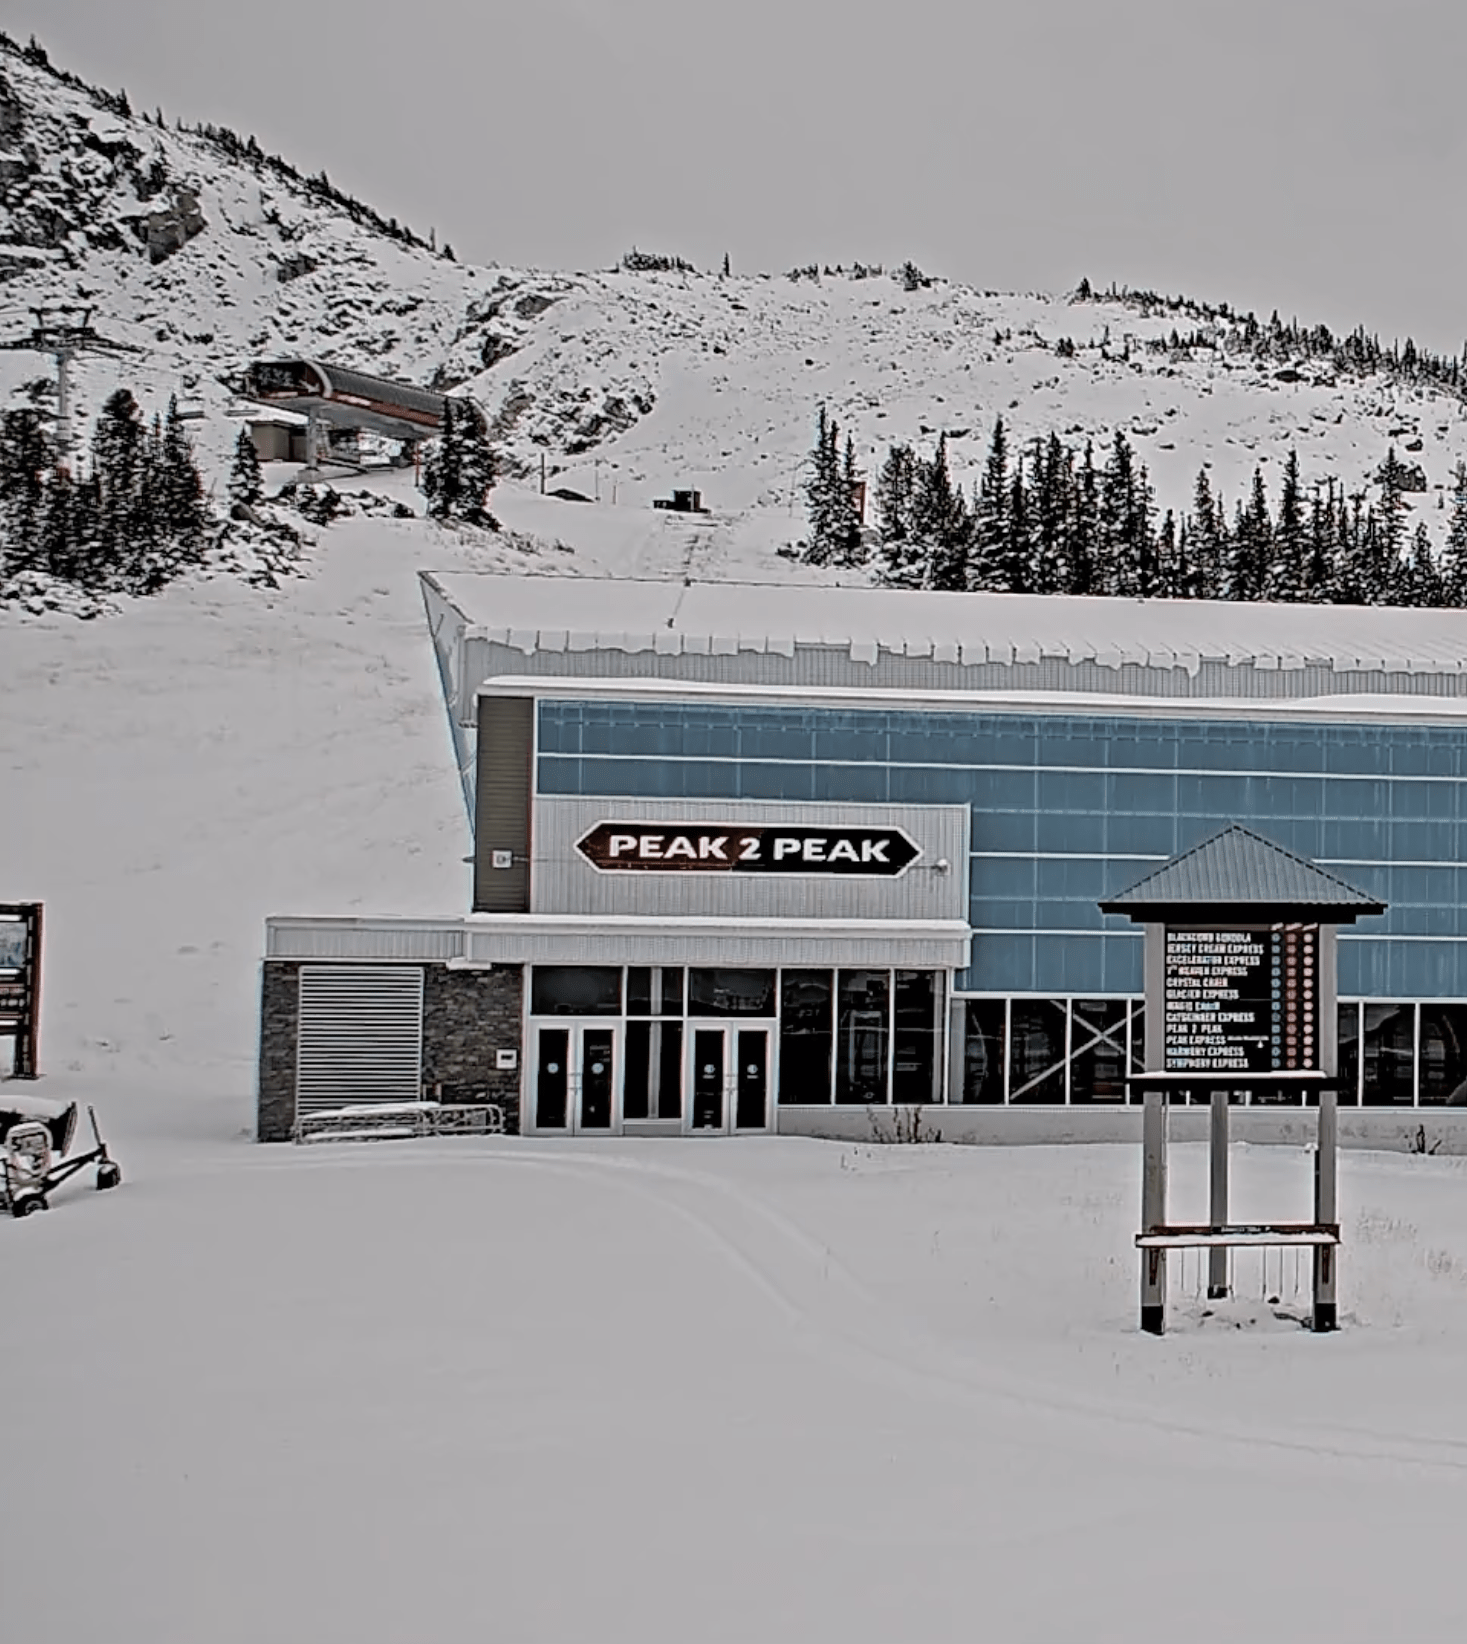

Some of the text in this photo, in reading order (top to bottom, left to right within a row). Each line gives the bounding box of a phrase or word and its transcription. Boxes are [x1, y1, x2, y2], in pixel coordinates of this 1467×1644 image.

[609, 835, 889, 861] PEAK 2 PEAK
[1168, 944, 1263, 954] JERSEY CREAM EXPRESS
[1166, 955, 1260, 965] EXCELERATOR EXPRESS
[1178, 967, 1209, 976] HEAVEN
[1211, 967, 1247, 976] EXPRESS
[1166, 978, 1228, 987] CRYSTAL CHAIR
[1166, 990, 1239, 999] GLACIER EXPRESS
[1195, 1002, 1220, 1011] CHAIR
[1166, 1012, 1255, 1022] CATSKINNER EXPRESS
[1167, 1024, 1188, 1033] PEAK
[1201, 1024, 1222, 1034] PEAK
[1166, 1036, 1187, 1045] PEAK
[1189, 1036, 1226, 1045] EXPRESS
[1166, 1046, 1244, 1056] HARMONY EXPRESS
[1212, 1058, 1248, 1068] EXPRESS
